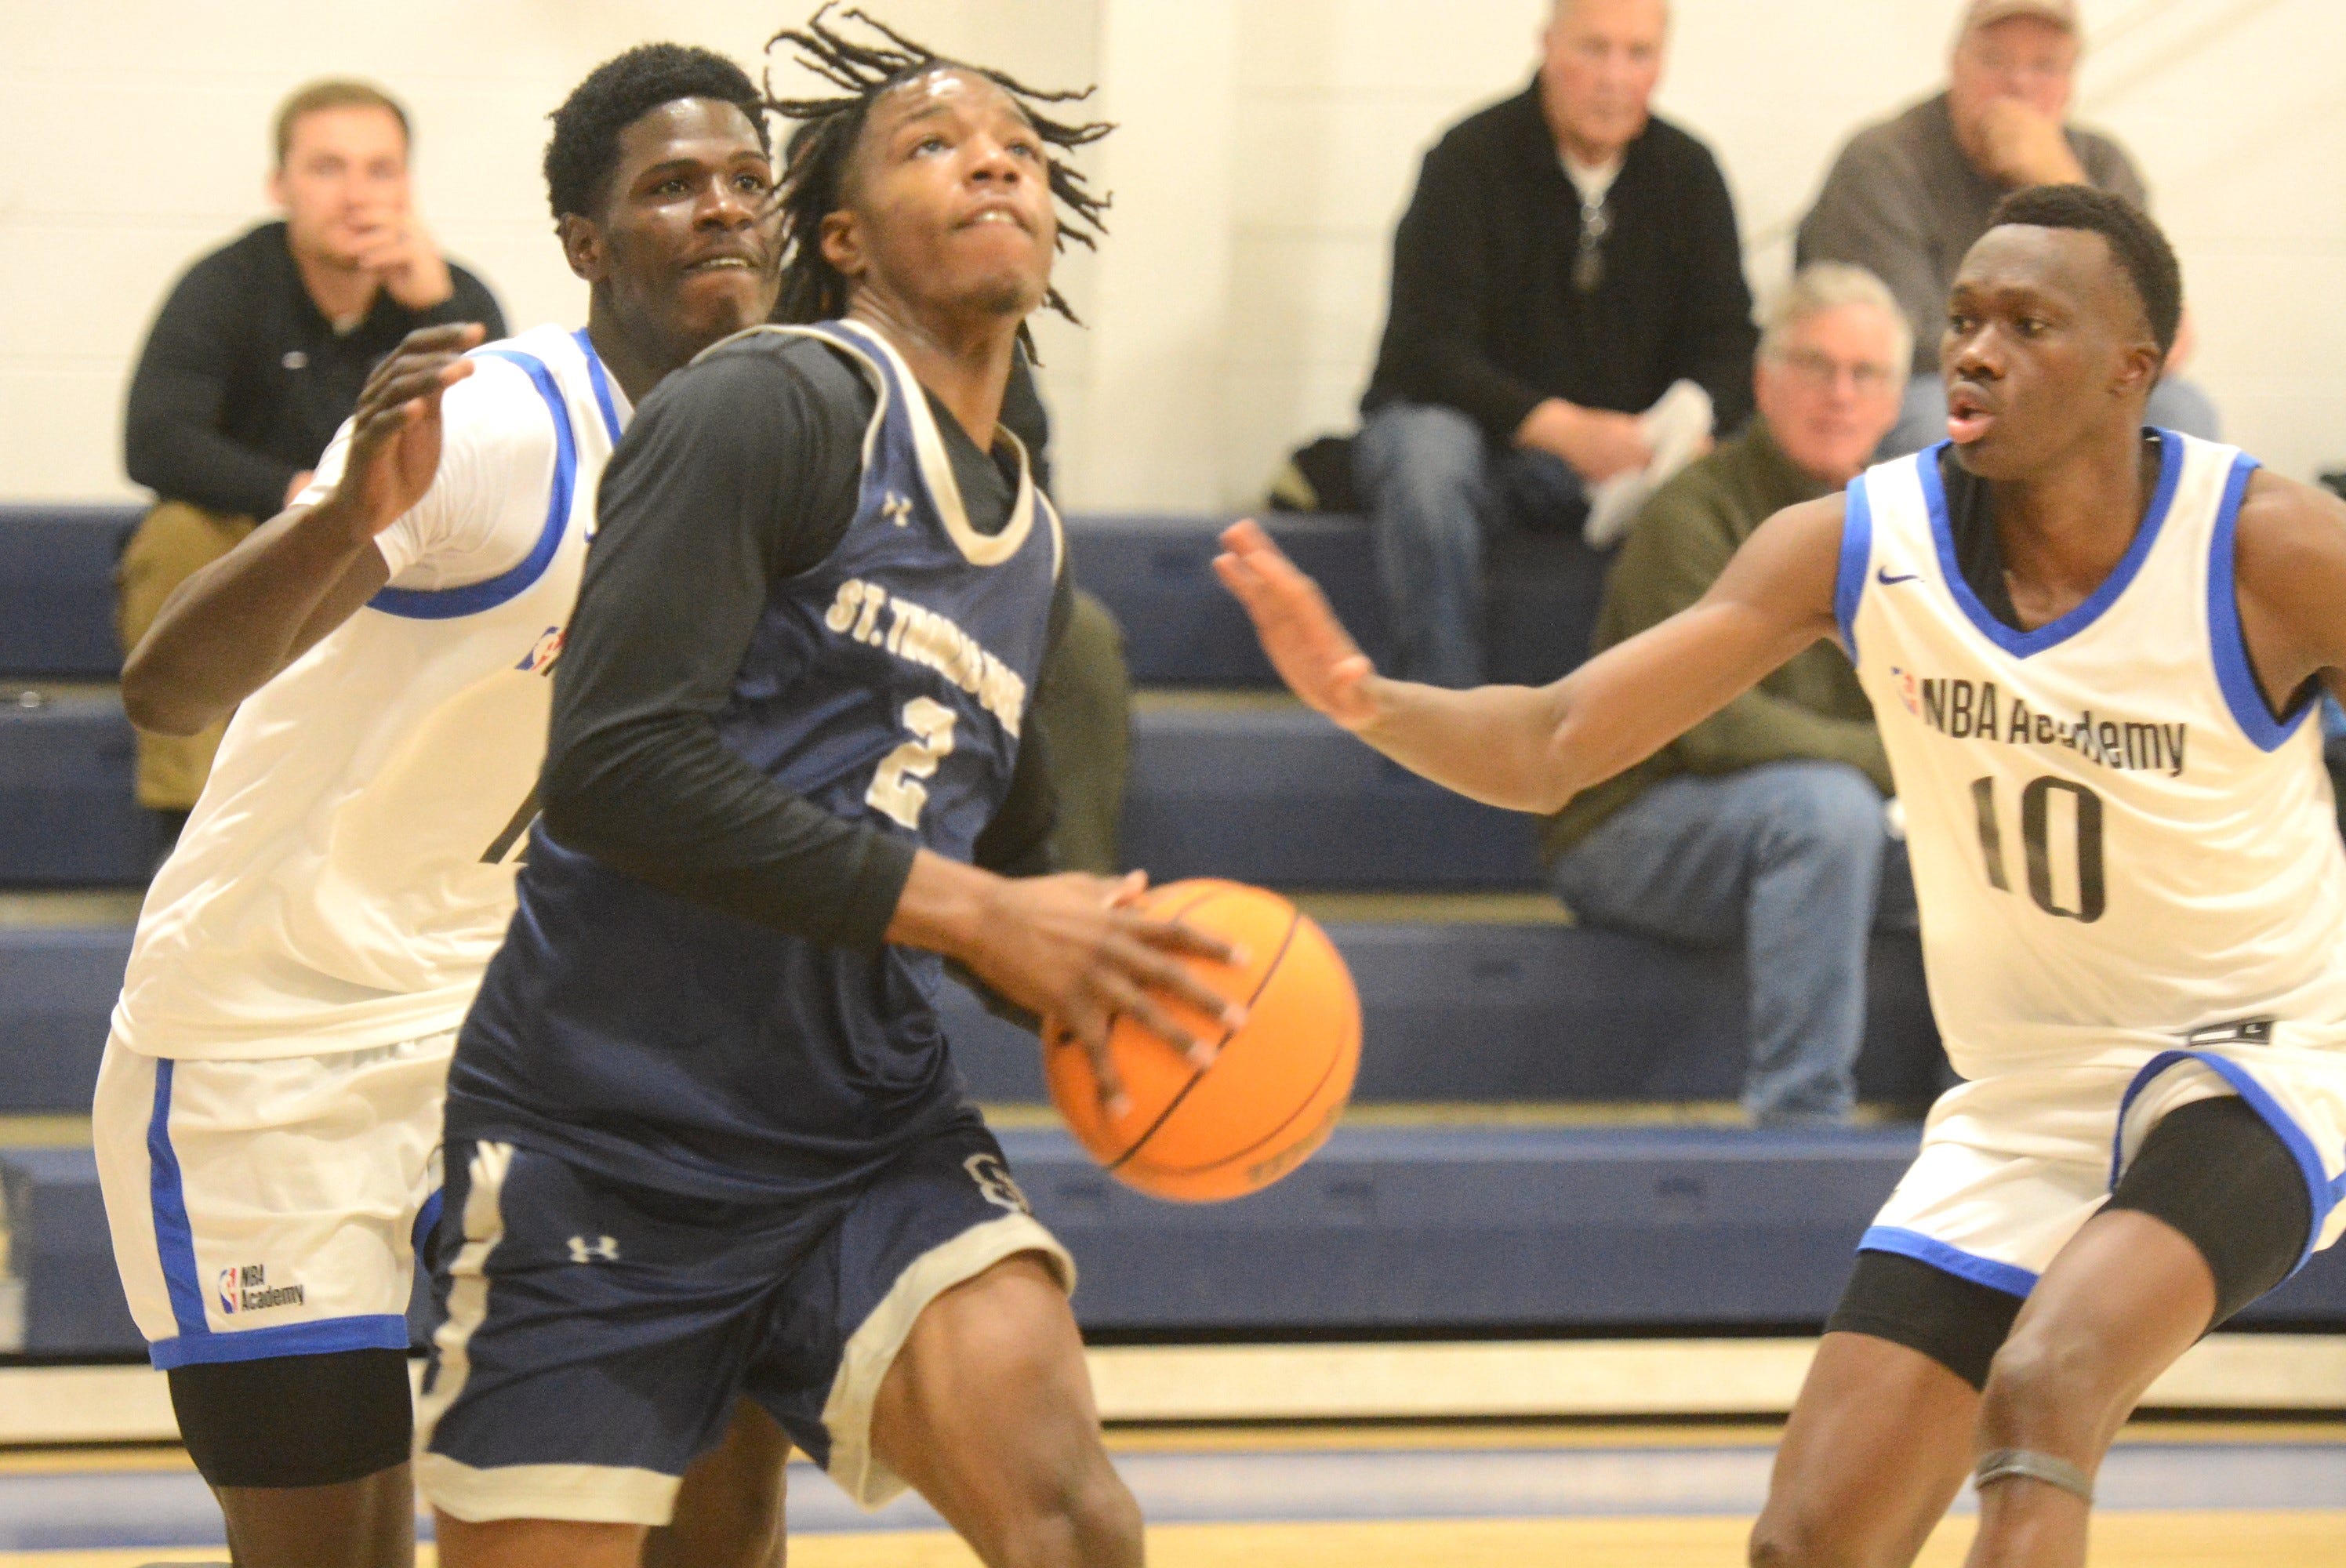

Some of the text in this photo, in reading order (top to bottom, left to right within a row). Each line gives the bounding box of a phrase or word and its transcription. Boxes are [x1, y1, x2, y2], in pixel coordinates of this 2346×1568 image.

[1921, 677, 1999, 741] NBA
[864, 695, 958, 831] 2
[1969, 775, 2106, 924] 10
[240, 1263, 264, 1287] NBA
[241, 1283, 303, 1312] Academy
